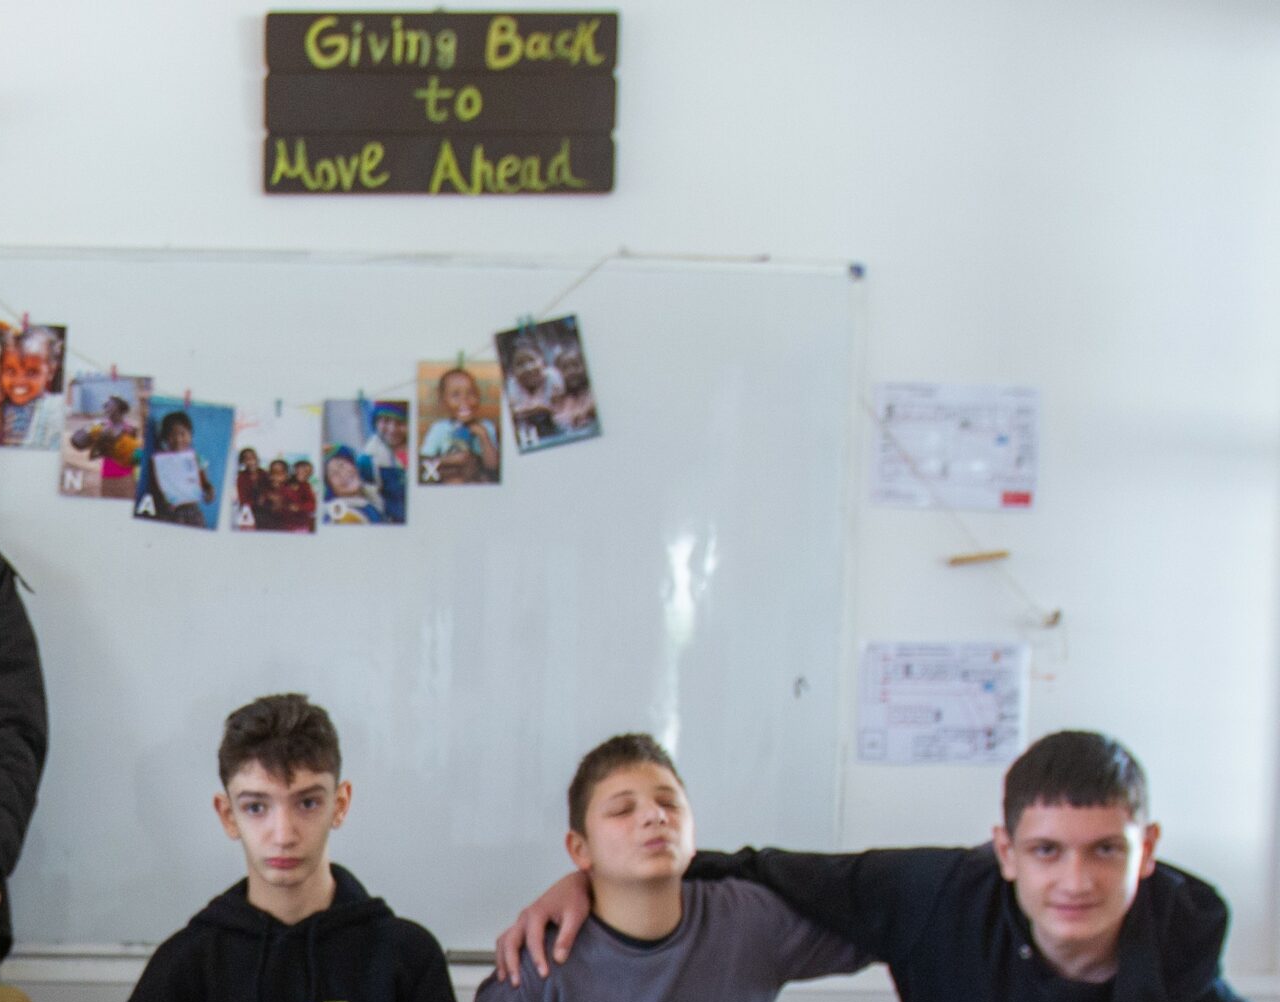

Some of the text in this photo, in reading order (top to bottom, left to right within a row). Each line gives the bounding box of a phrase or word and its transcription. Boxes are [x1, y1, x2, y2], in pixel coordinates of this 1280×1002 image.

[304, 16, 457, 70] Giving
[414, 75, 483, 123] to
[271, 137, 588, 196] Move Ahead
